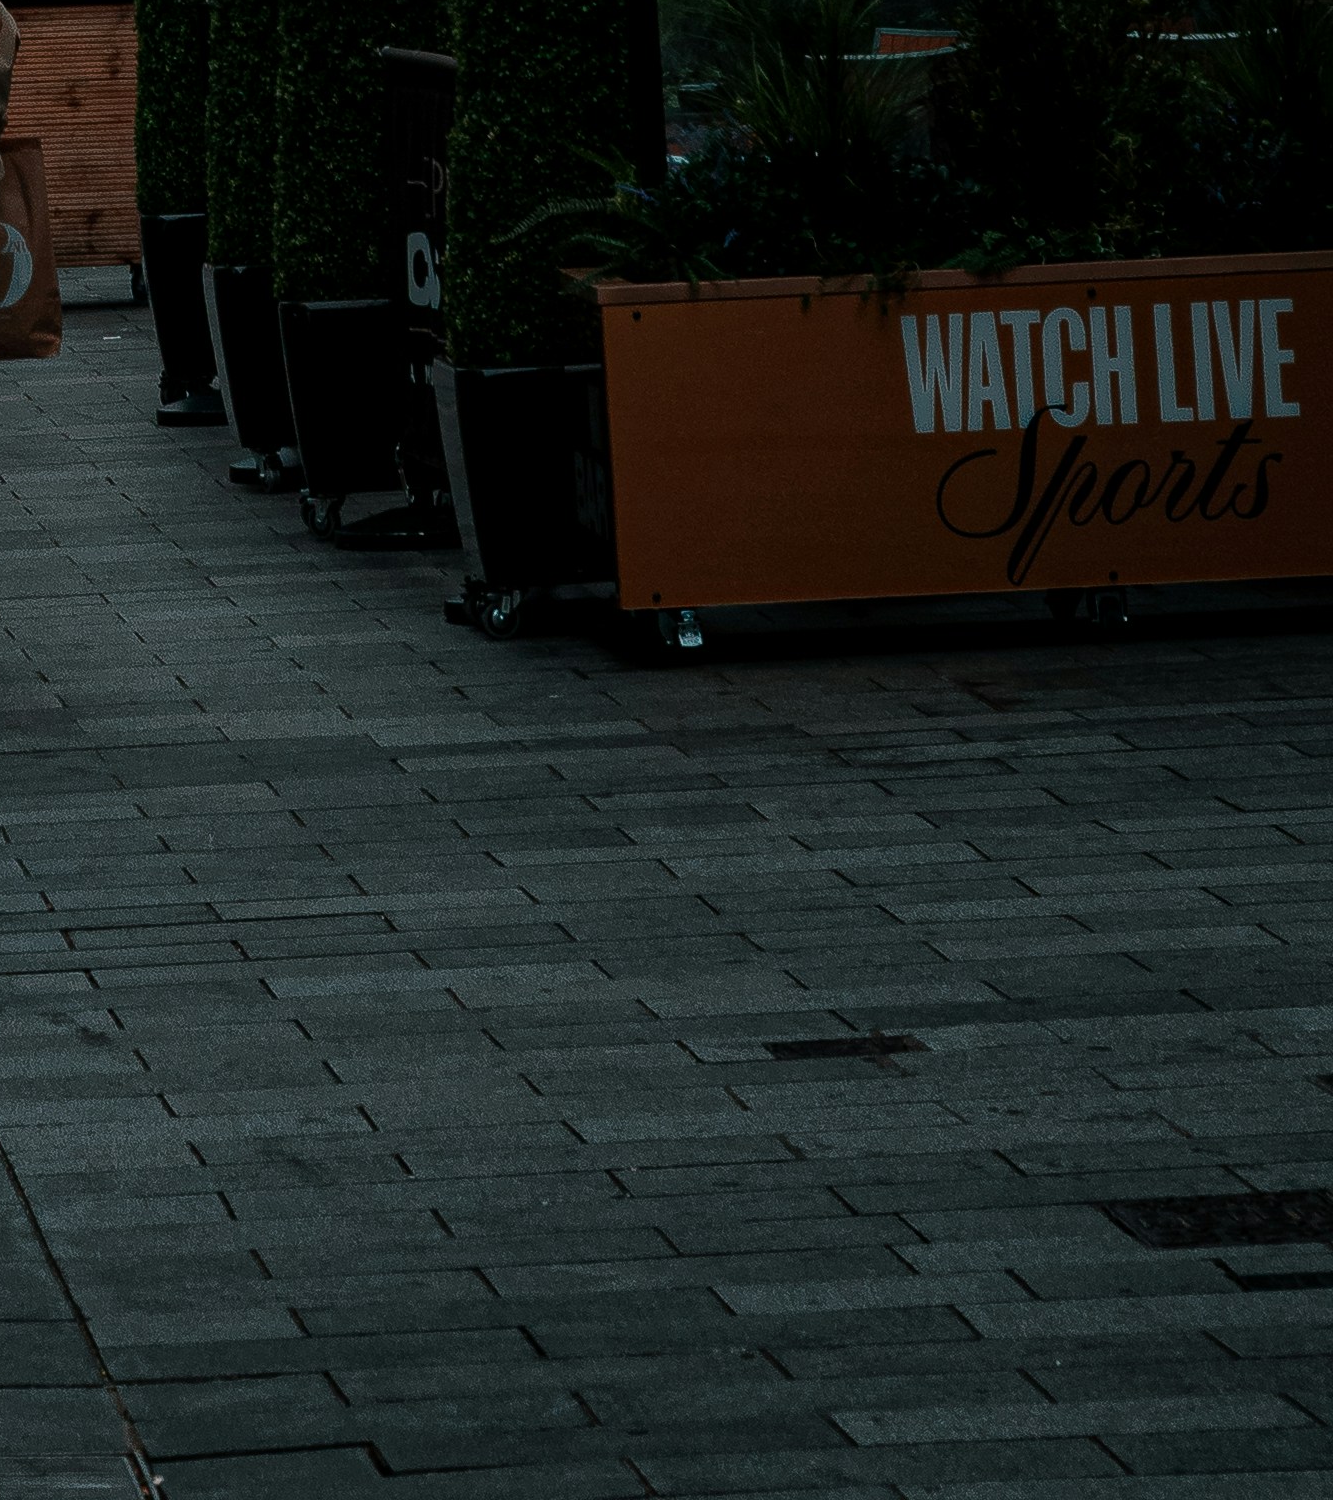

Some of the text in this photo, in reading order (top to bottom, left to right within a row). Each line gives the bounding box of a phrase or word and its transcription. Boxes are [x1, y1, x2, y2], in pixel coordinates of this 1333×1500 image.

[900, 297, 1301, 434] WATCH LIVE
[935, 403, 1284, 586] Sports
